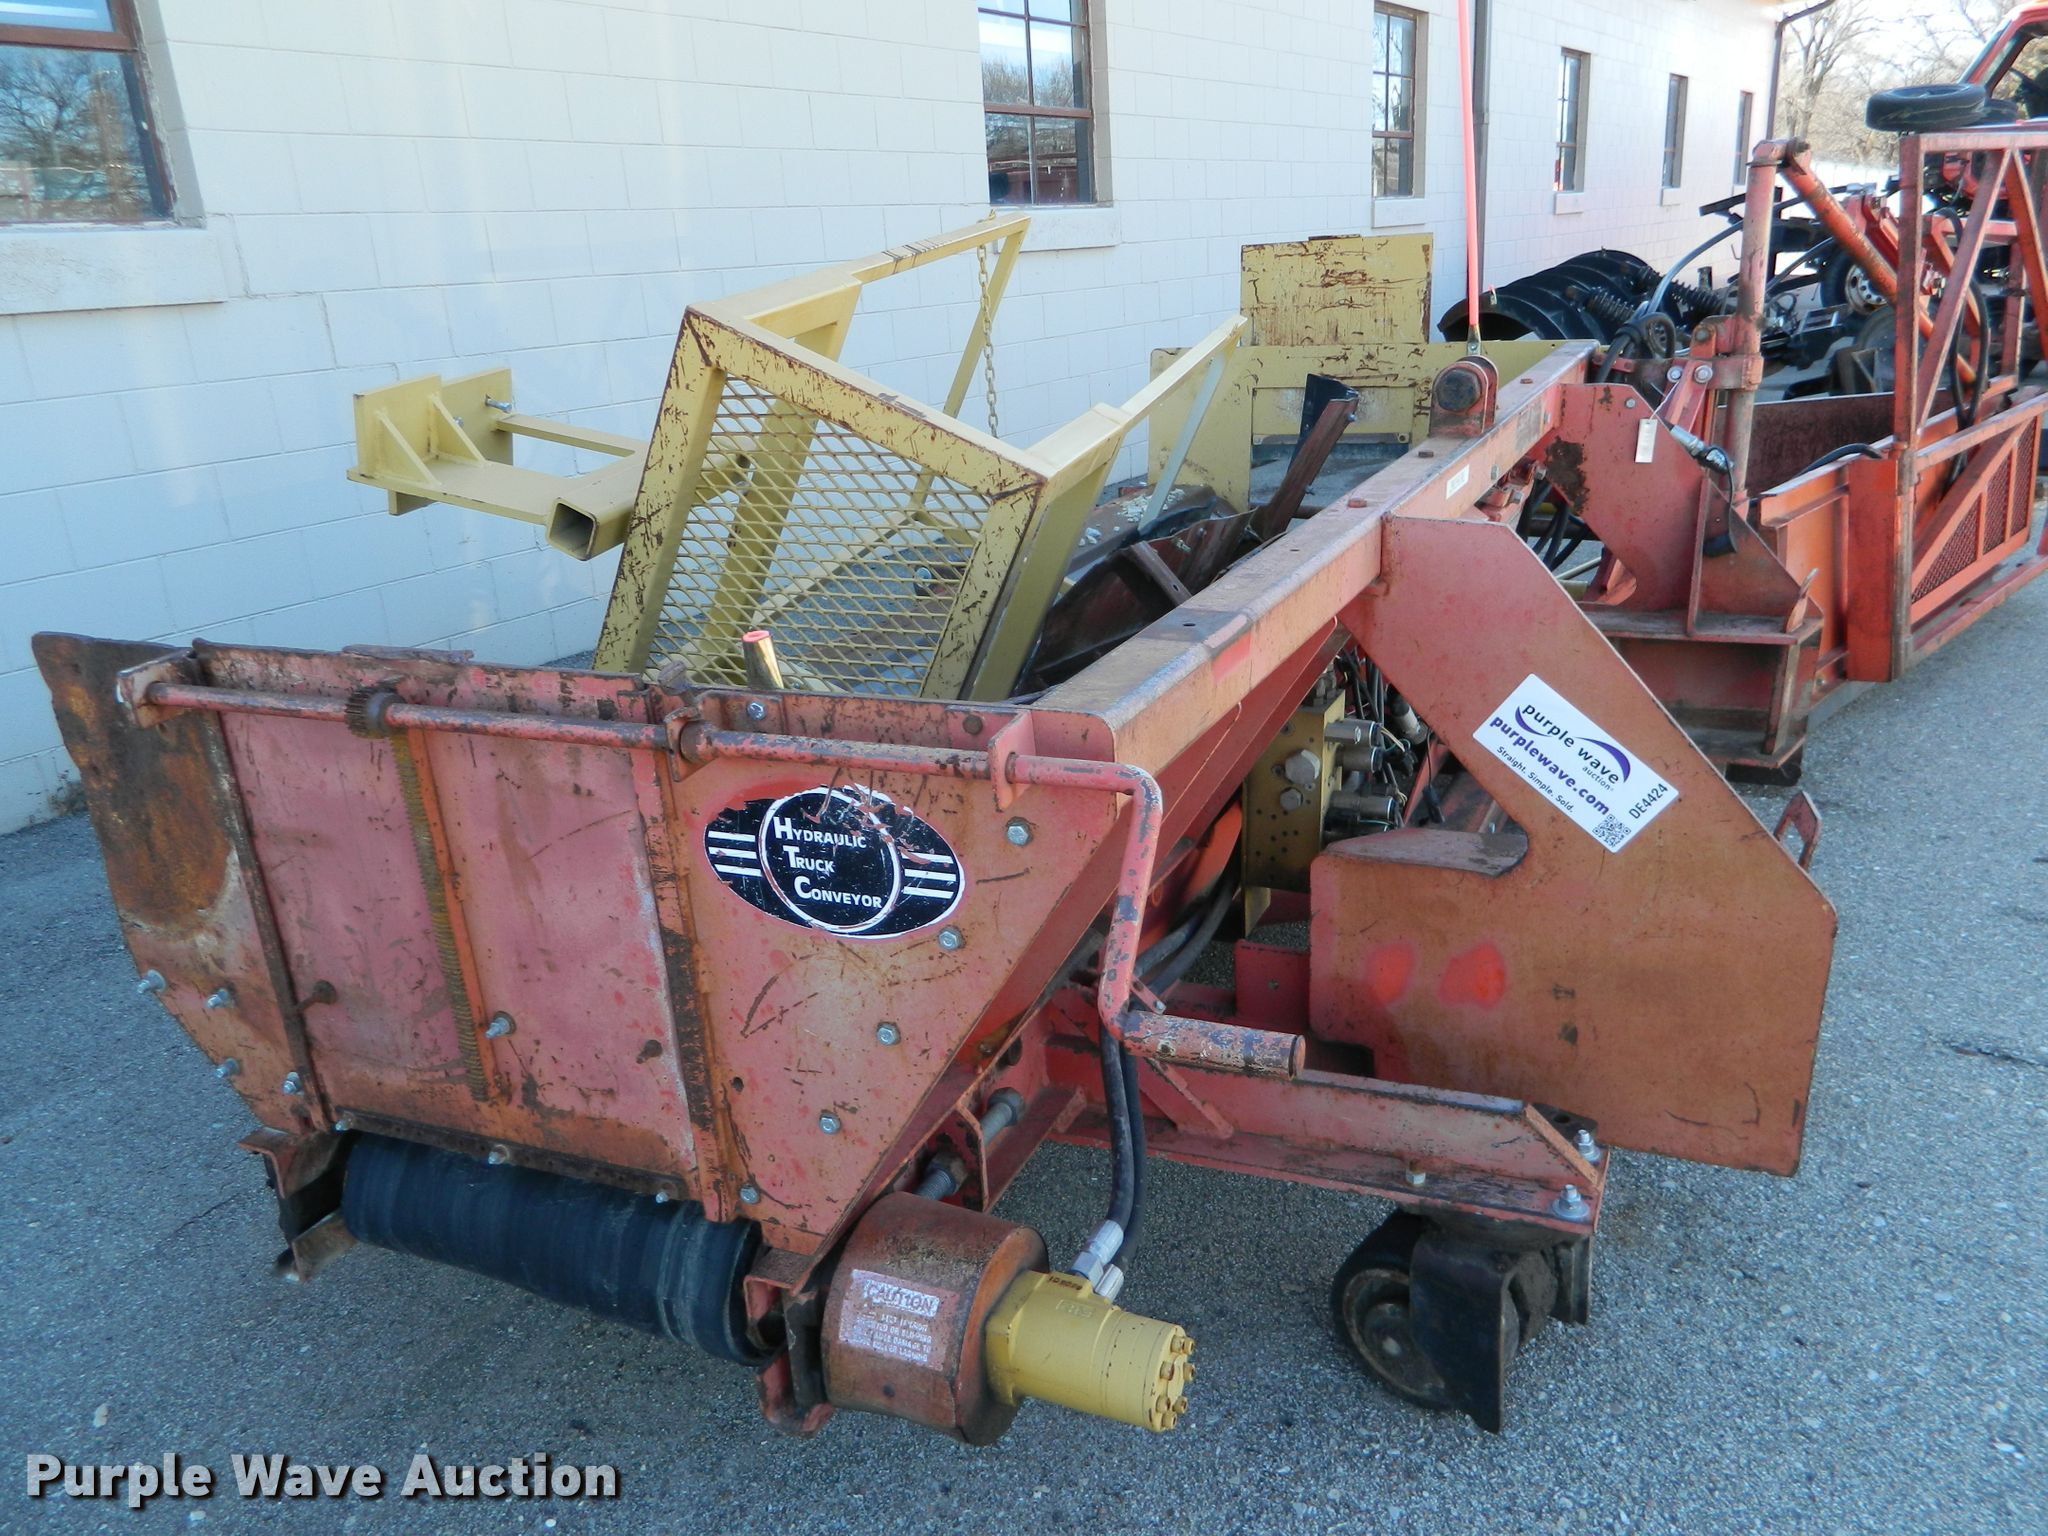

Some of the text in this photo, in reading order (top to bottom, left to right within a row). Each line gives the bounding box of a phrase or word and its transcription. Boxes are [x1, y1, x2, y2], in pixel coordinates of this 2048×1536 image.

[1522, 704, 1619, 785] purple wave
[1490, 716, 1610, 816] purplewave.com
[1496, 745, 1574, 813] Straight. Simple. Sold.
[1582, 765, 1611, 791] auction
[1629, 783, 1668, 819] DE4424
[773, 816, 867, 849] HYDRAULIC
[783, 845, 836, 873] TRUCK
[794, 875, 882, 909] CONVEYOR
